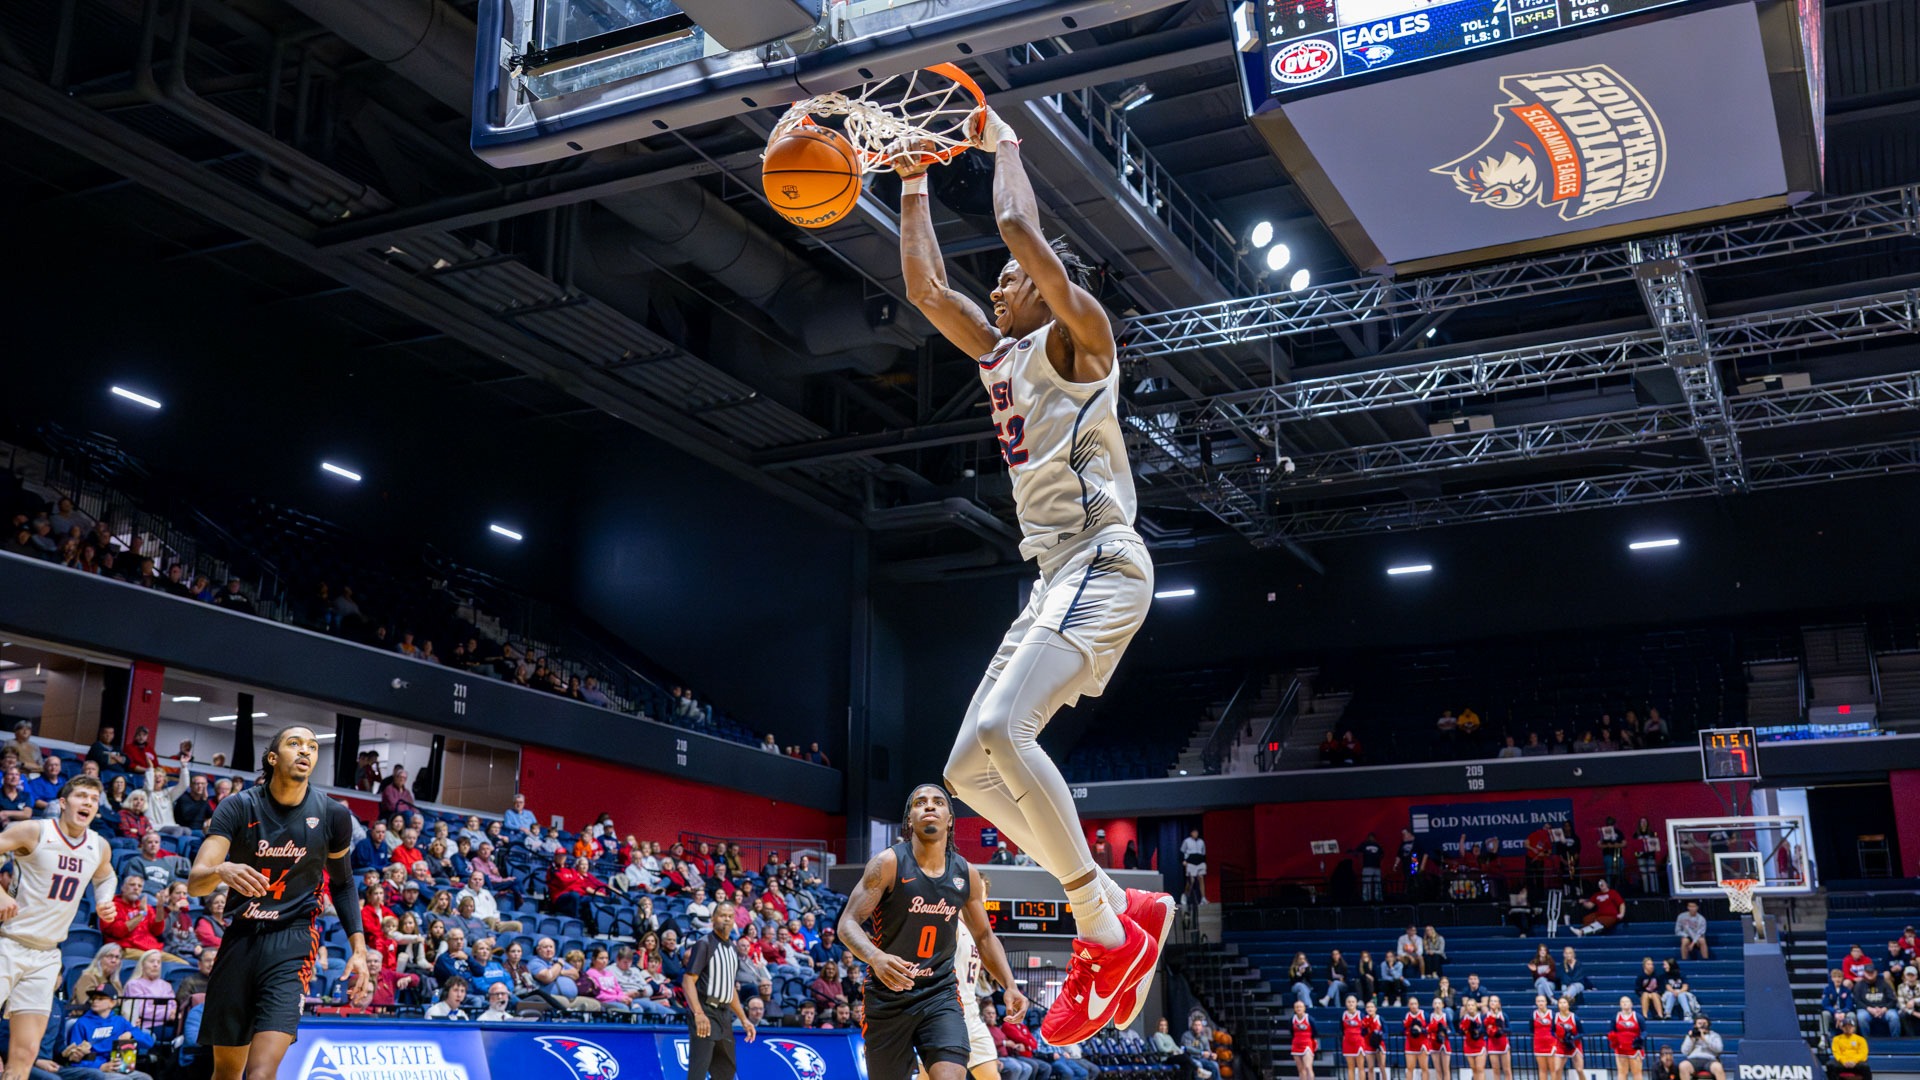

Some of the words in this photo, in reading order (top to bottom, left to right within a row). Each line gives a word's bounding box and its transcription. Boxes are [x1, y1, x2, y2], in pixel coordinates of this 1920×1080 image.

[1268, 12, 1276, 21] 7
[1297, 4, 1304, 14] 0
[1514, 9, 1555, 26] PLY-FLS
[1571, 7, 1600, 21] FLS:
[1601, 4, 1609, 14] 0
[1270, 25, 1283, 36] 14
[1298, 19, 1306, 29] 0
[1327, 12, 1335, 22] 2
[1341, 13, 1431, 49] EAGLES
[1461, 20, 1490, 33] TOL:
[1491, 15, 1499, 26] 4
[1464, 31, 1492, 45] FLS:
[1492, 29, 1500, 39] 0
[1285, 50, 1322, 73] OVC
[1517, 75, 1624, 215] INDIANA
[1565, 71, 1658, 204] SOUTHERN
[1522, 109, 1573, 164] SCREAMING
[1556, 159, 1577, 195] EAGLES
[453, 683, 467, 699] 211
[453, 701, 466, 716] 111
[676, 738, 688, 753] 210
[1731, 749, 1748, 774] 7
[1466, 765, 1484, 777] 209
[1072, 787, 1088, 798] 209
[1468, 779, 1485, 790] 109
[1431, 816, 1459, 829] OLD
[1461, 813, 1528, 828] NATIONAL
[1530, 811, 1568, 824] BANK
[255, 839, 307, 864] Bowling
[1442, 841, 1483, 852] STUET
[58, 854, 83, 873] USI
[47, 873, 80, 902] 10
[242, 901, 280, 920] Green
[908, 895, 957, 922] Bowling
[984, 901, 1000, 911] USI
[1020, 902, 1055, 917] 17:51
[917, 925, 937, 959] 0
[332, 1045, 437, 1067] TRI-STATE
[1738, 1064, 1813, 1080] ROMAIN
